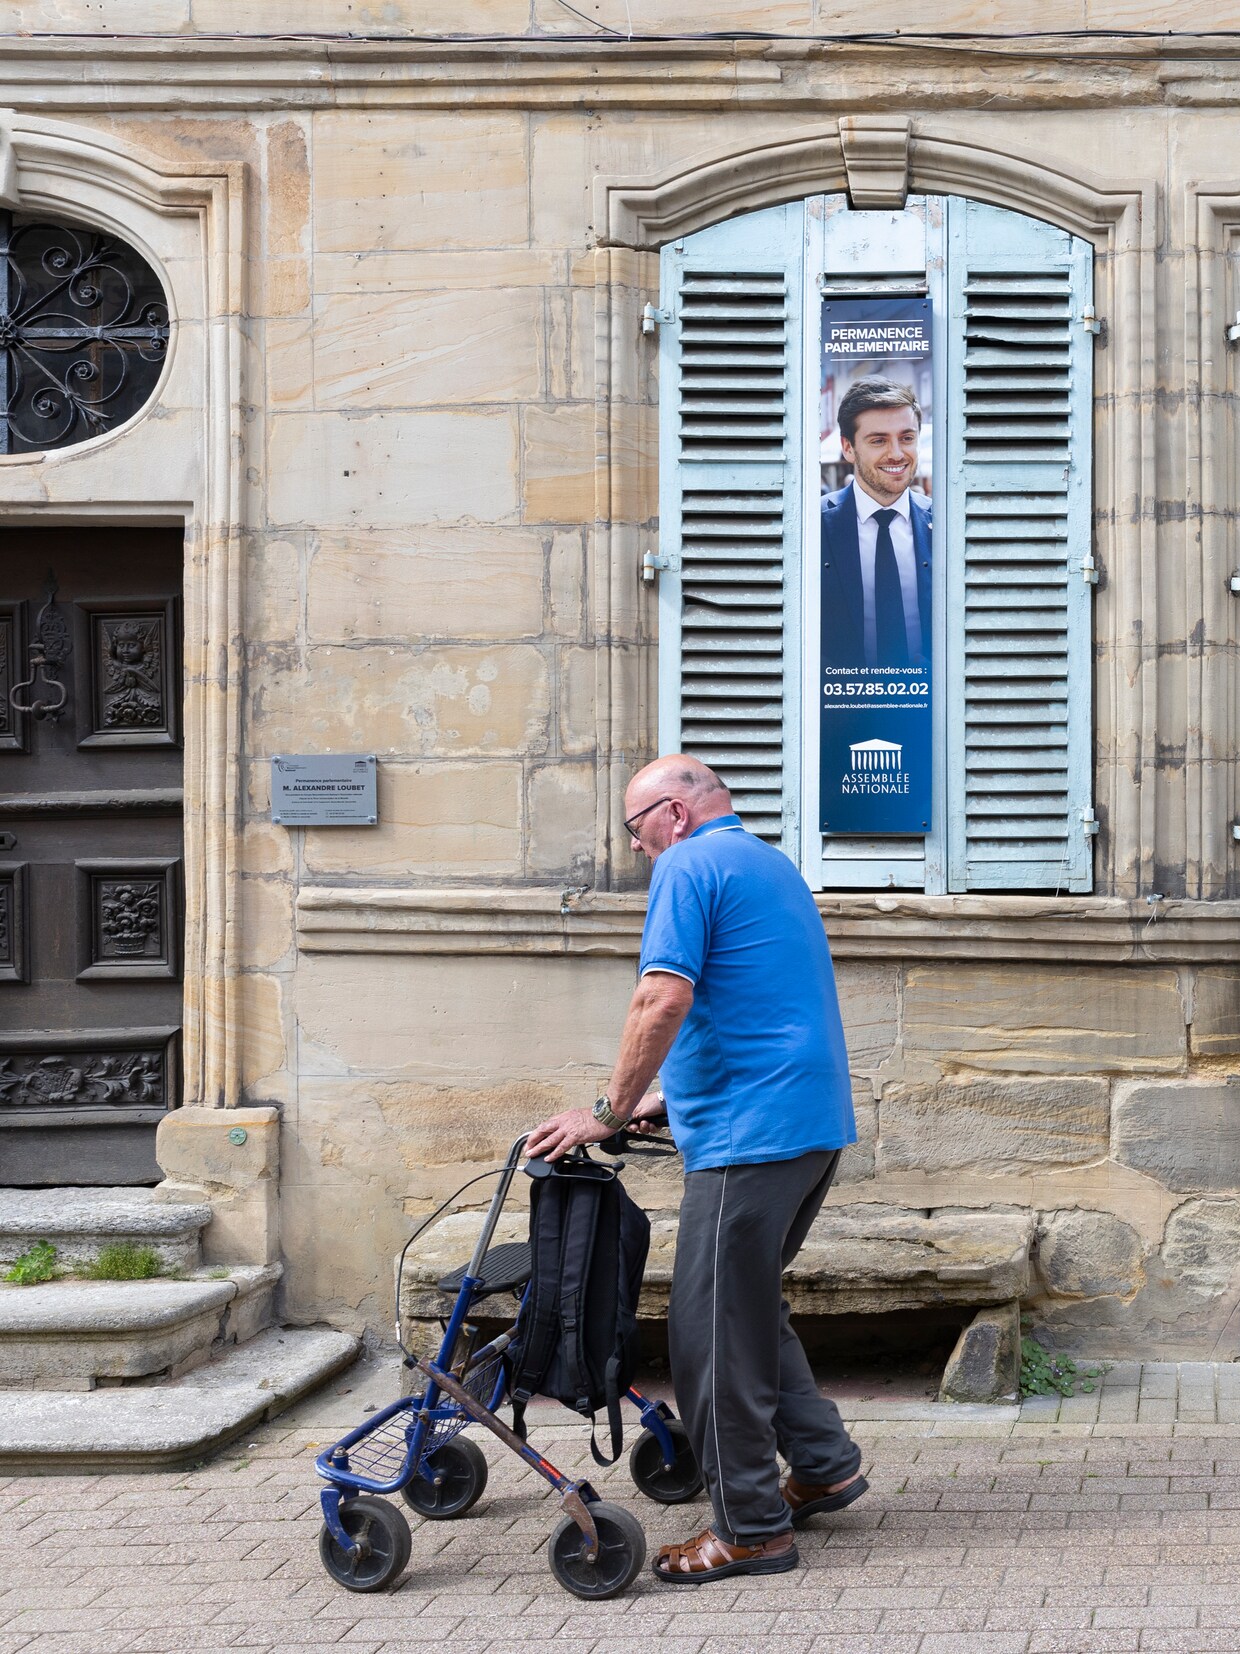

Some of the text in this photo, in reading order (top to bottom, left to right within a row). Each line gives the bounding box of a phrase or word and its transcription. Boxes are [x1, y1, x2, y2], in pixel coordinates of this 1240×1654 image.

[831, 327, 922, 339] PERMANENCE
[825, 340, 929, 353] PARLEMENTAIRE
[825, 667, 858, 675] Contact
[860, 667, 869, 675] et
[871, 667, 922, 675] rendez-vous
[823, 683, 929, 696] 03.57.85.02.02
[842, 771, 910, 783] ASSEMBLÉE
[842, 784, 910, 793] NATIONALE
